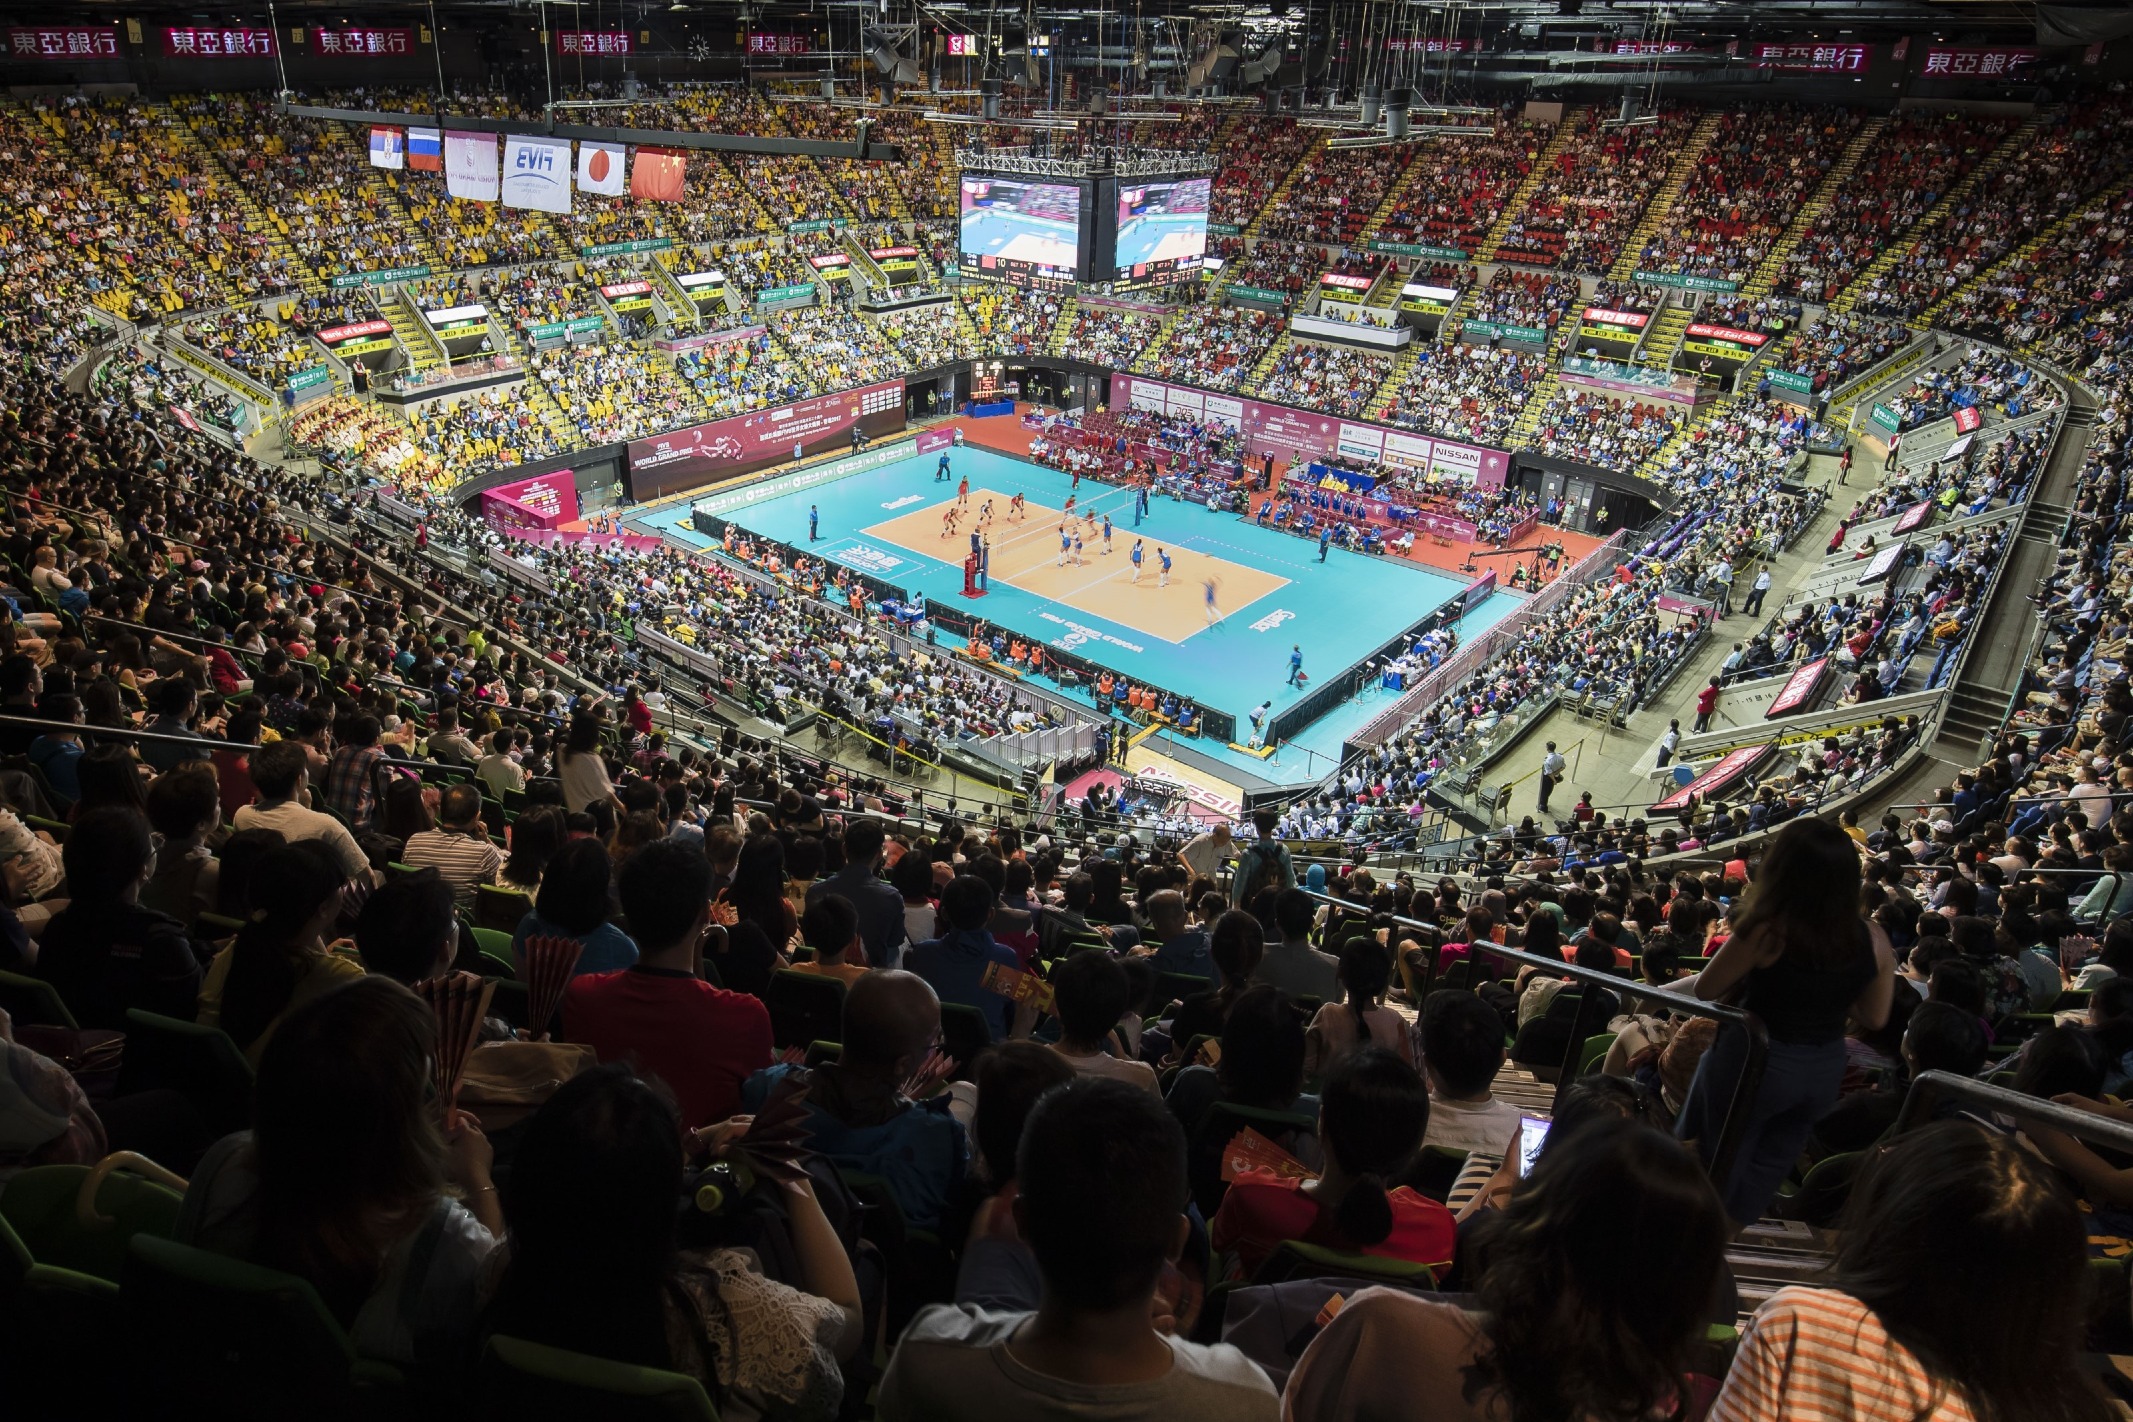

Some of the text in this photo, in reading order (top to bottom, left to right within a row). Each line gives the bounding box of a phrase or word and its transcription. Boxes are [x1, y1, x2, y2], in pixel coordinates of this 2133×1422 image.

[11, 33, 116, 54] 東亞銀行
[130, 33, 141, 42] 72
[170, 32, 270, 54] 東亞銀行
[292, 32, 303, 42] 73
[321, 32, 406, 53] 東亞銀行
[562, 34, 628, 53] 東亞銀行
[750, 35, 804, 53] 東亞銀行
[1760, 46, 1863, 69] 東亞銀行
[1893, 50, 1905, 59] 47
[2084, 54, 2098, 64] 48
[996, 258, 1006, 267] 10
[1027, 262, 1034, 271] 7
[1146, 263, 1154, 272] 10
[1170, 259, 1175, 268] 7
[1327, 274, 1367, 288] 東亞銀行
[1590, 309, 1641, 325] 東亞銀行
[320, 322, 387, 340] Bank of East Asia
[1690, 325, 1762, 342] Bank of East Asia
[657, 441, 670, 450] FIVB
[634, 455, 657, 467] WORLD
[658, 450, 680, 461] GRAND
[680, 446, 693, 455] PRIX
[1435, 447, 1479, 462] NISSAN
[1039, 612, 1144, 653] WORLD GRAND PRIX
[1141, 766, 1242, 812] NISSN
[1421, 829, 1435, 842] 58
